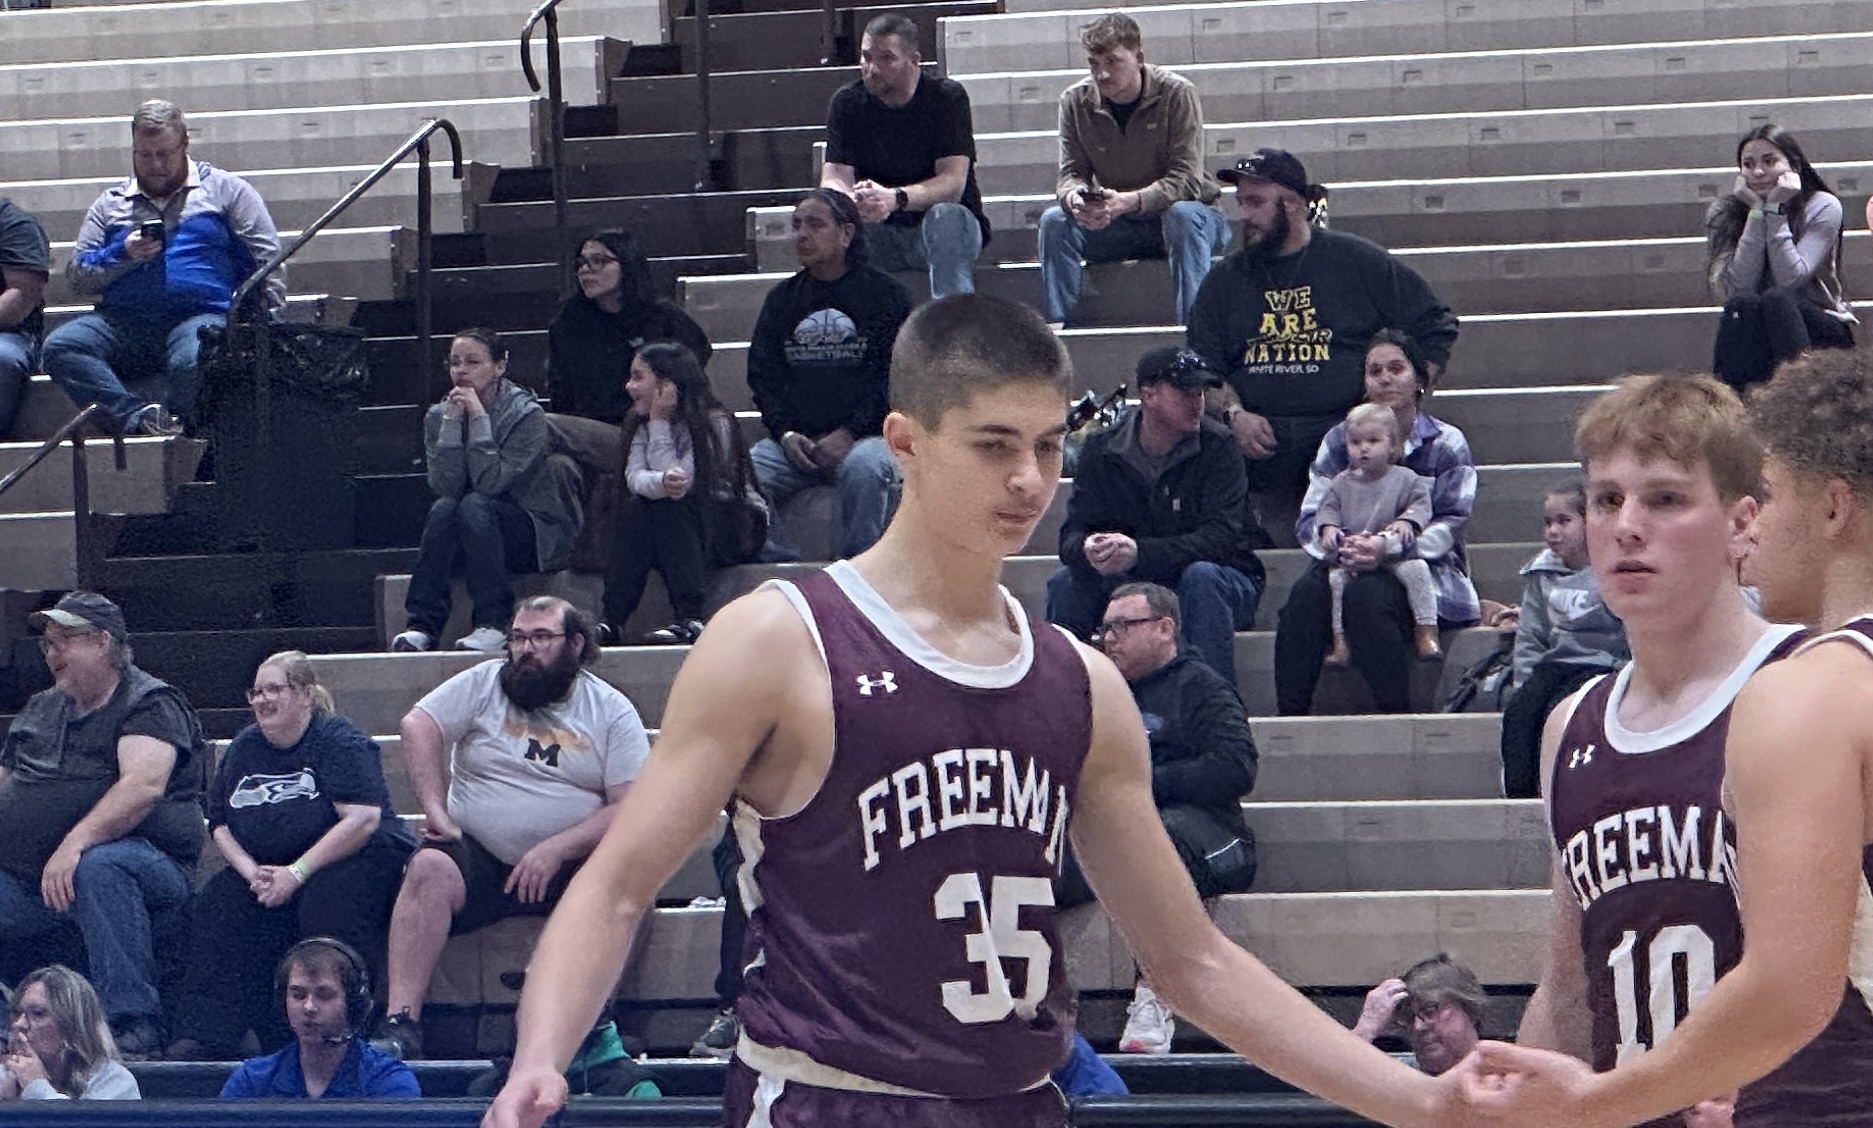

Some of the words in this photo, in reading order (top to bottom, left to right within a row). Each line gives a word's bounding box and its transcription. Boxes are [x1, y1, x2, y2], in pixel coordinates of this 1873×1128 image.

[1259, 307, 1318, 338] ARE
[1265, 286, 1311, 311] WE
[1244, 343, 1331, 365] NATION
[524, 737, 561, 768] M
[857, 747, 1069, 878] FREEMA
[1561, 803, 1741, 911] REEMA
[933, 871, 1056, 1024] 35
[1607, 923, 1717, 1069] 10
